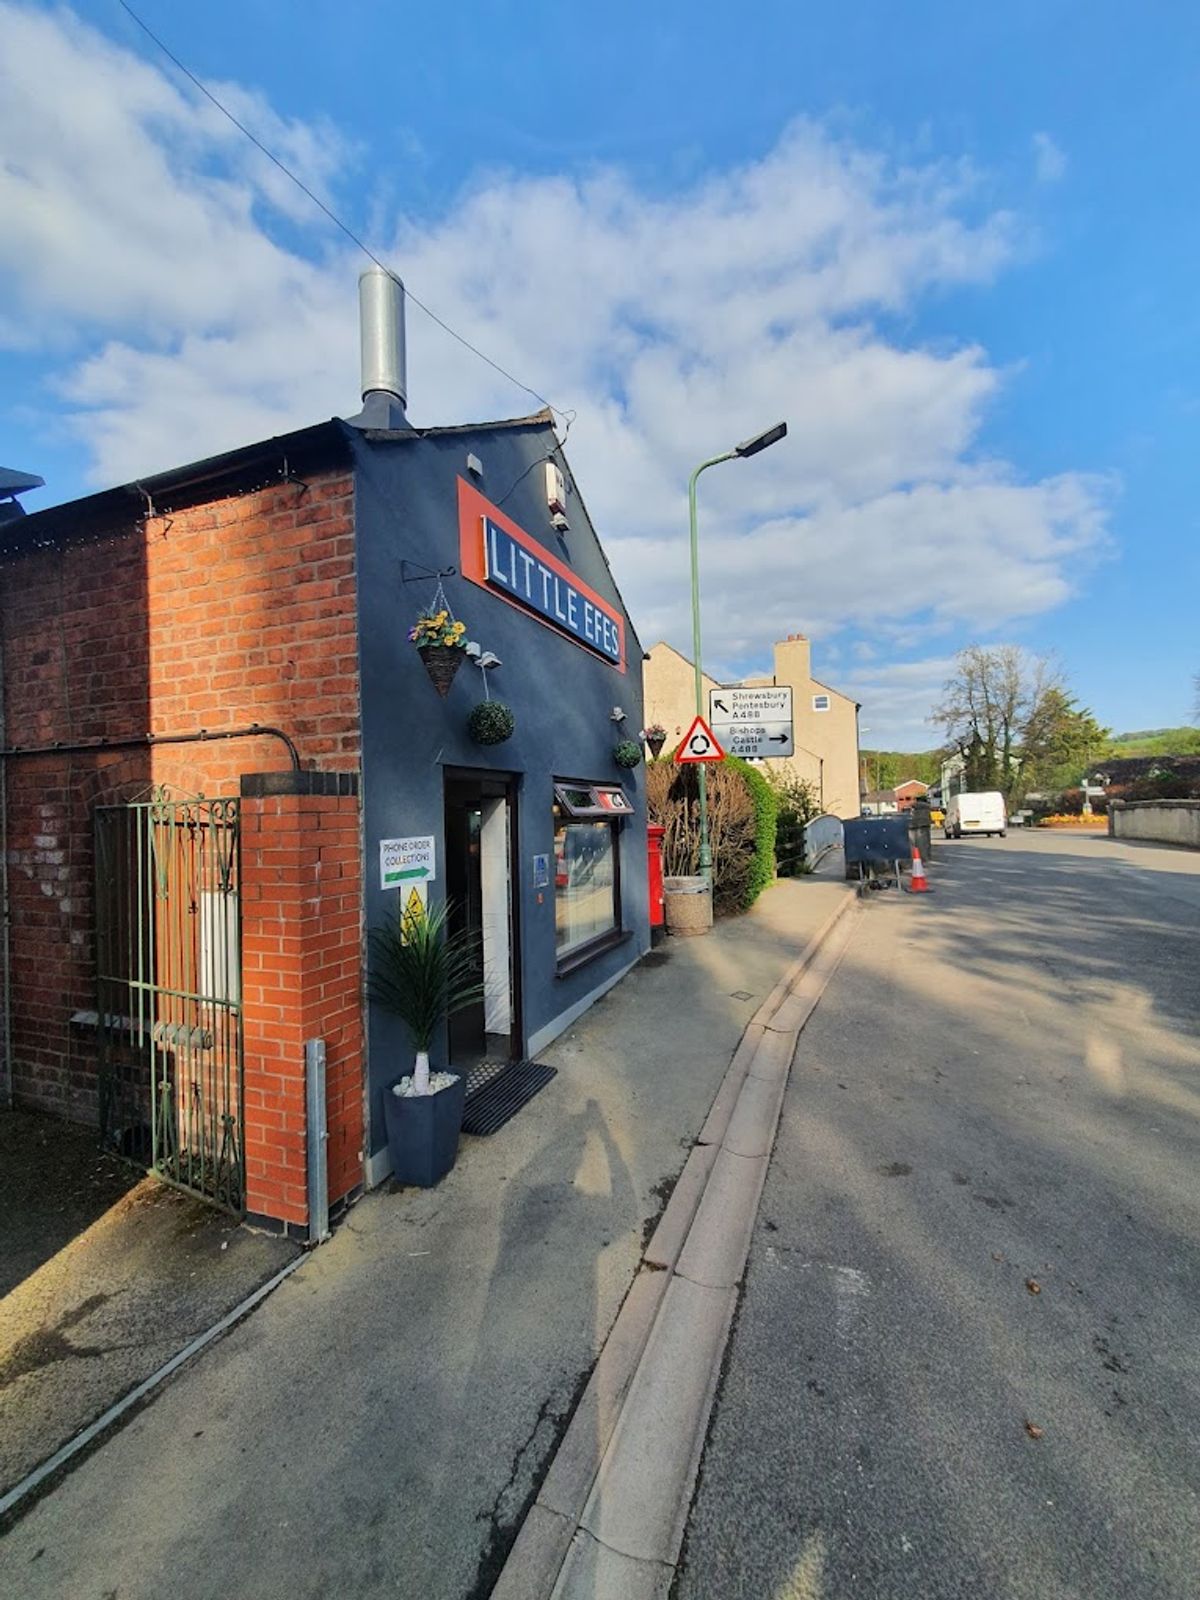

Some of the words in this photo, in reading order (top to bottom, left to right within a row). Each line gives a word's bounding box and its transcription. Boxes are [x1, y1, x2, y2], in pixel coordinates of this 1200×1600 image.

[491, 528, 578, 630] LITTLE
[584, 600, 618, 656] EFES
[732, 692, 787, 700] Shrewsbury
[732, 735, 763, 744] Castle
